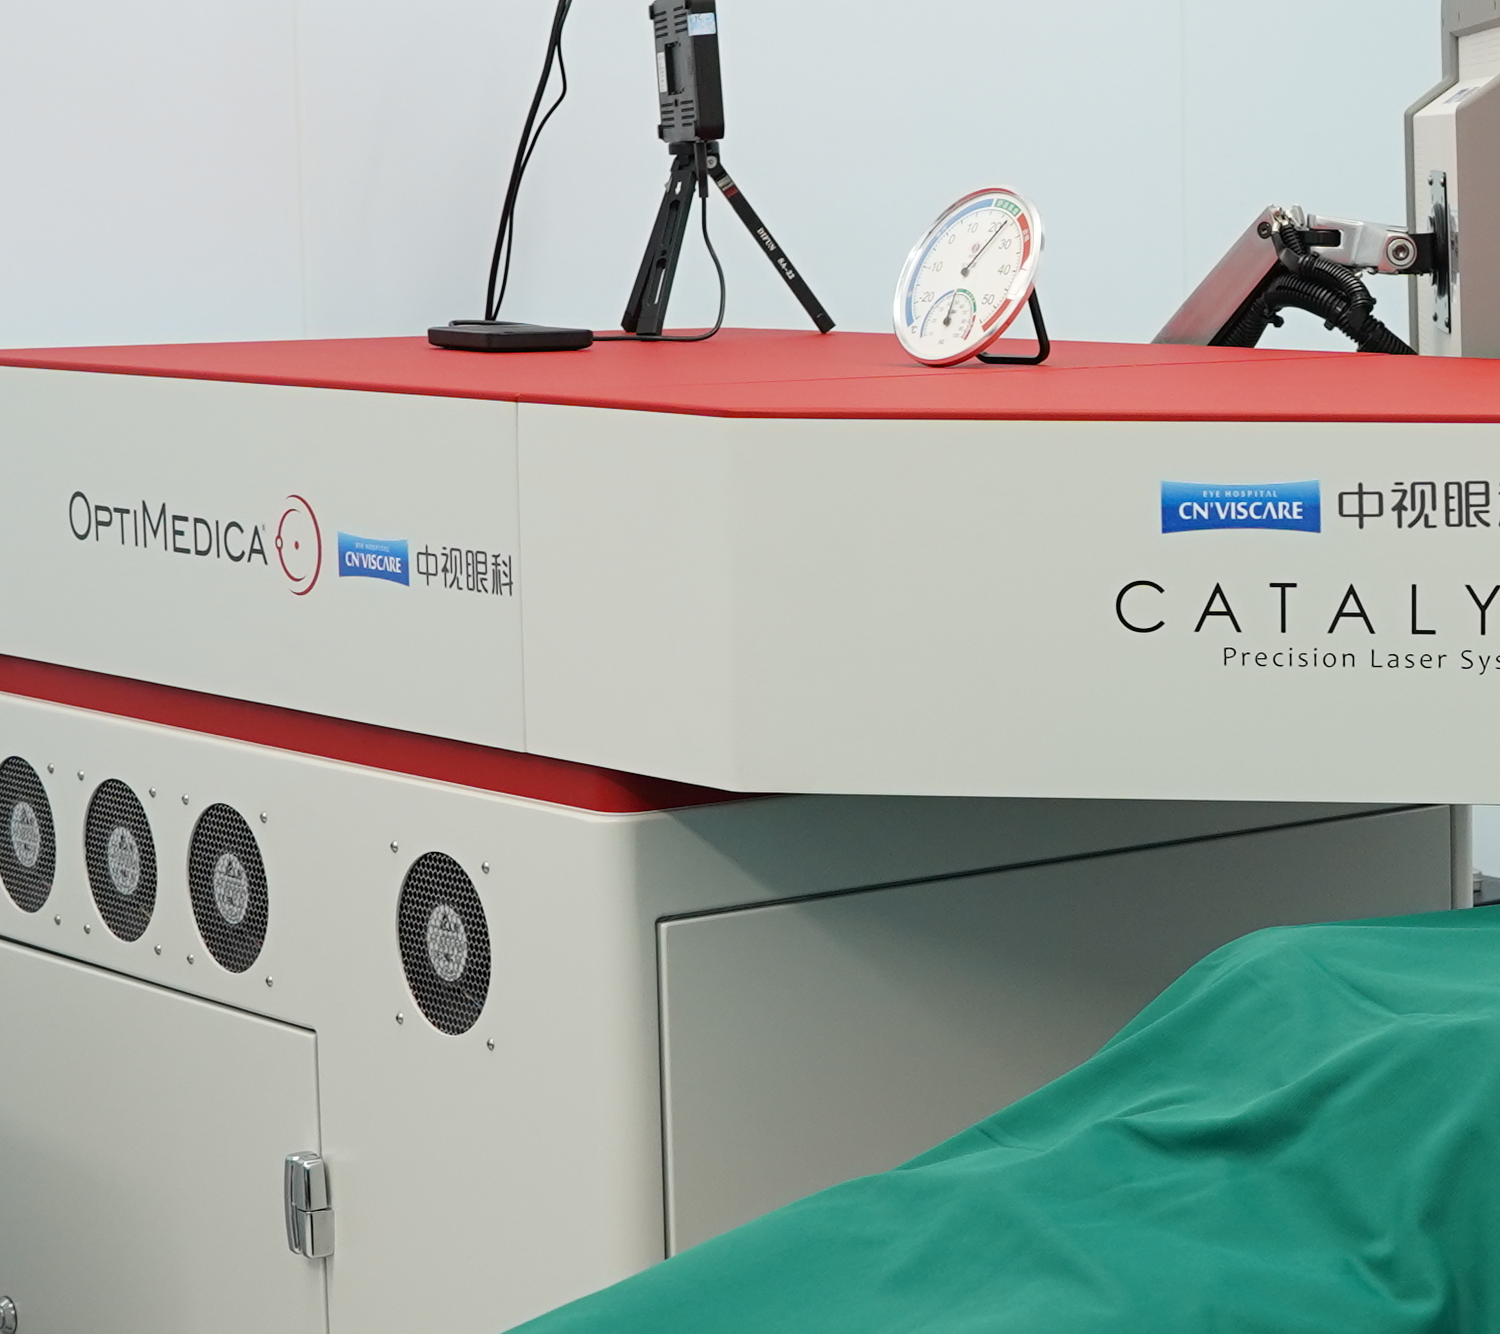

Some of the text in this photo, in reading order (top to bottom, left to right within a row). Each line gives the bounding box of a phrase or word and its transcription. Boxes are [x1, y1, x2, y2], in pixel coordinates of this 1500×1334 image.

[967, 223, 978, 233] 10
[988, 222, 1001, 233] 20
[948, 234, 956, 244] 0
[998, 239, 1011, 250] 30
[998, 265, 1011, 275] 40
[982, 294, 994, 305] 50
[1203, 490, 1278, 498] EYE HOSPITAL
[1178, 501, 1303, 520] CN'VISCARE
[416, 544, 514, 597] 中视眼科
[1224, 647, 1355, 668] Precision
[1371, 649, 1447, 669] Laser
